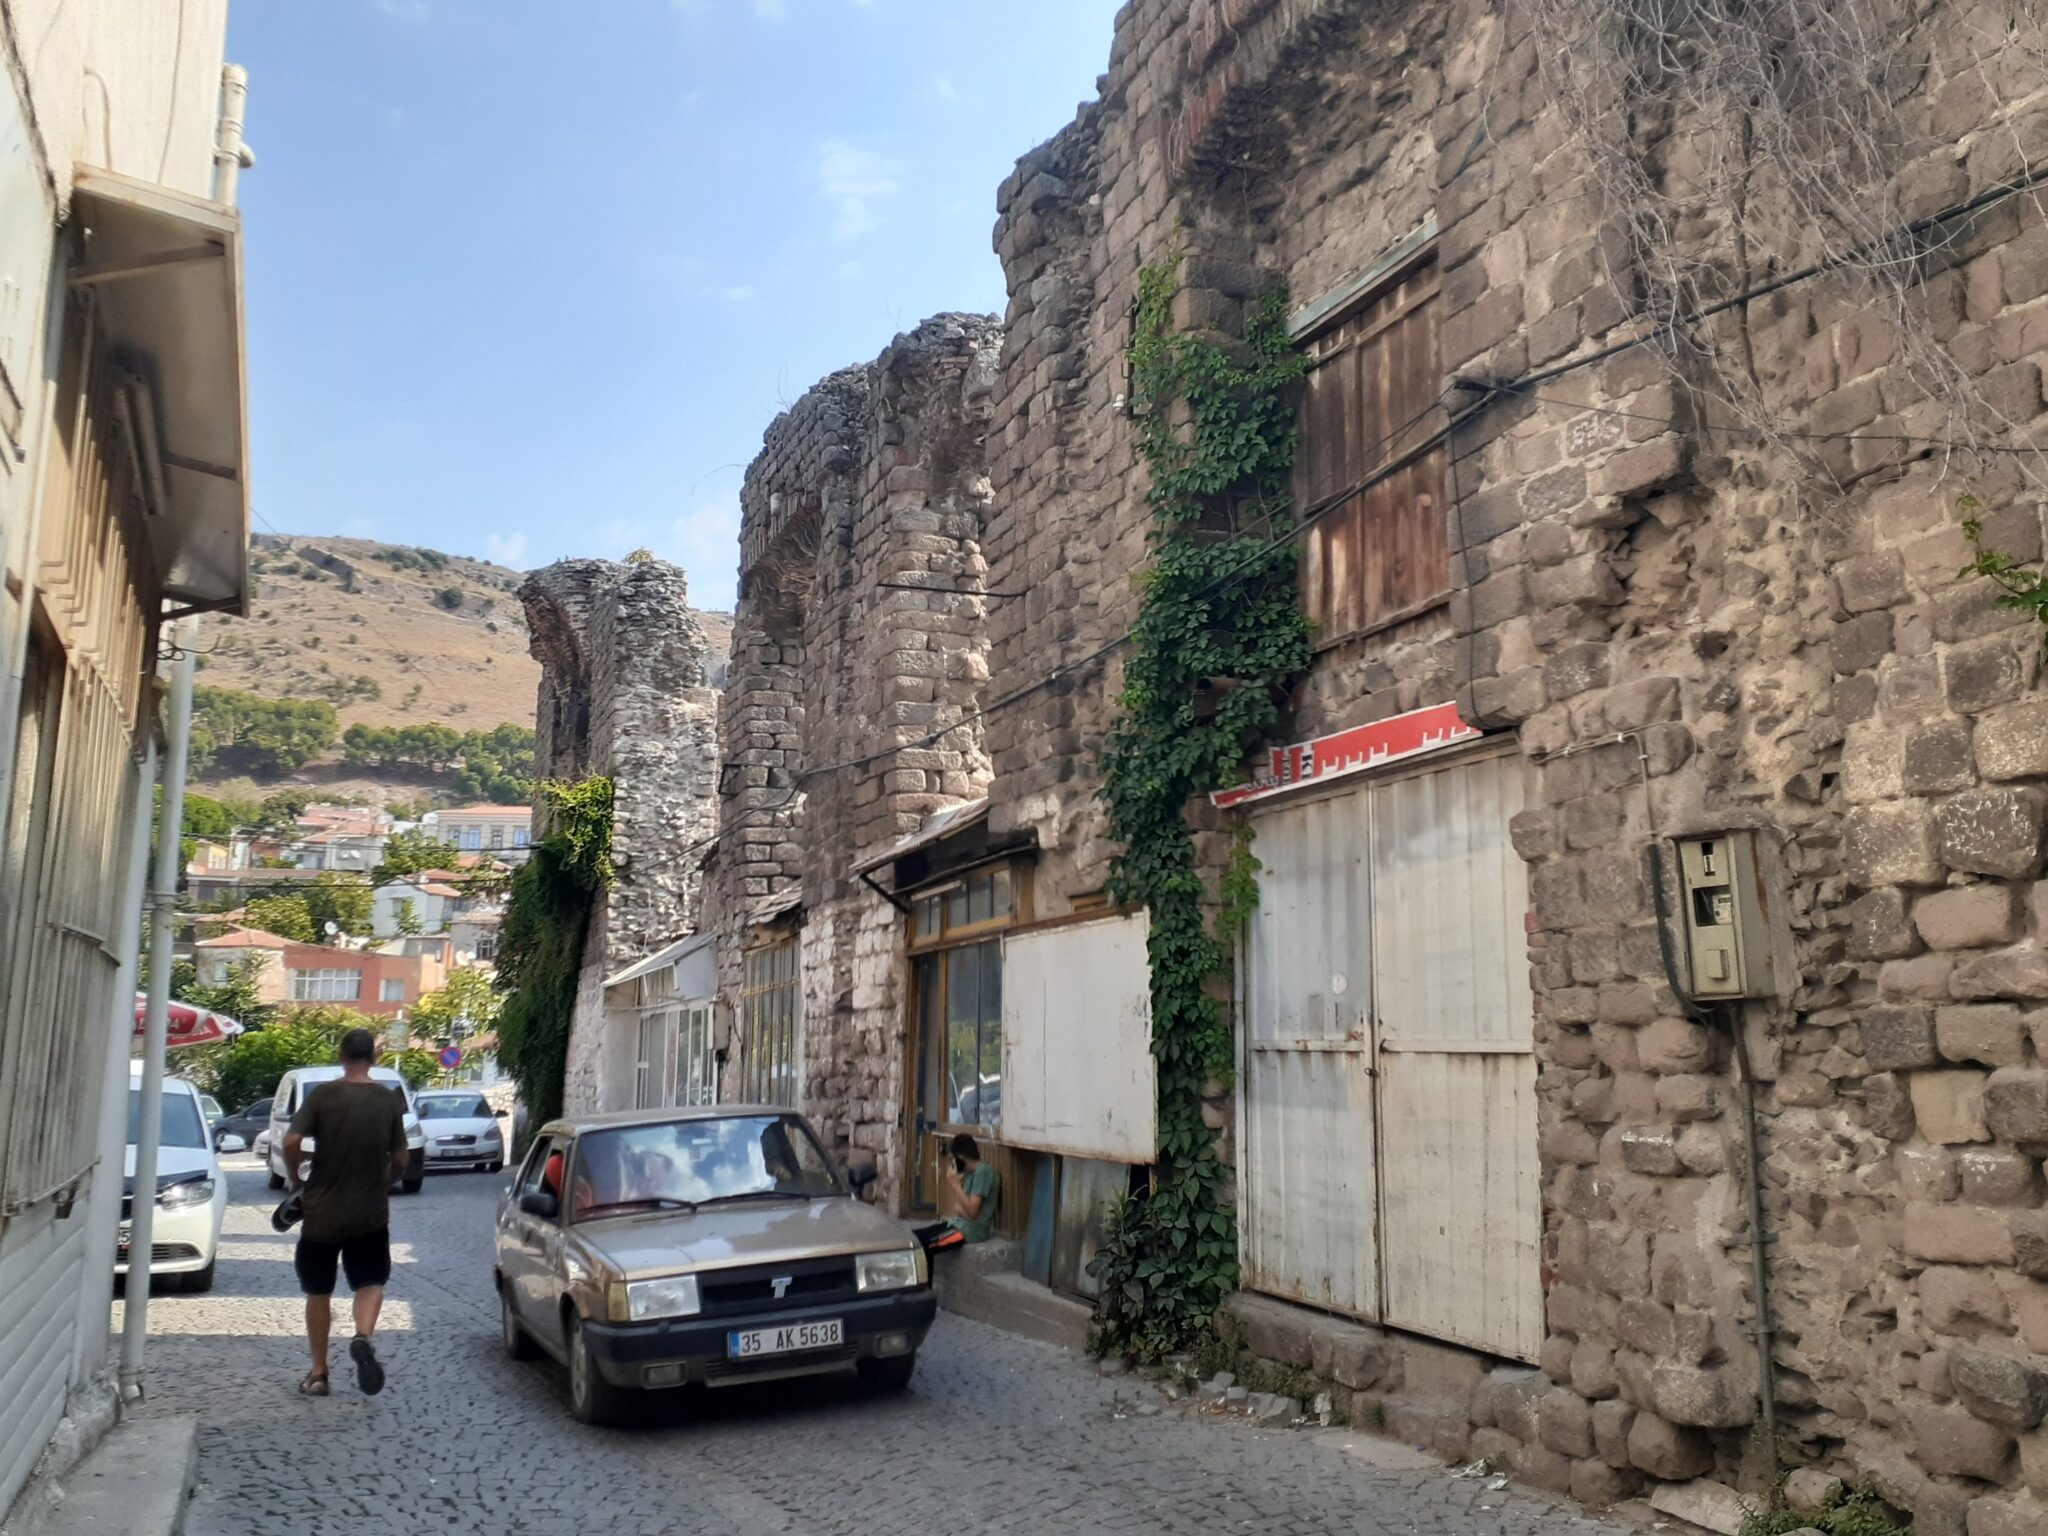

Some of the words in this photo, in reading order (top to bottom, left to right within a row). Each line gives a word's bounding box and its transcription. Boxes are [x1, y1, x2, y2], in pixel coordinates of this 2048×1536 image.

[741, 1333, 761, 1353] 35
[776, 1328, 795, 1350] AK
[800, 1323, 839, 1345] 5638
